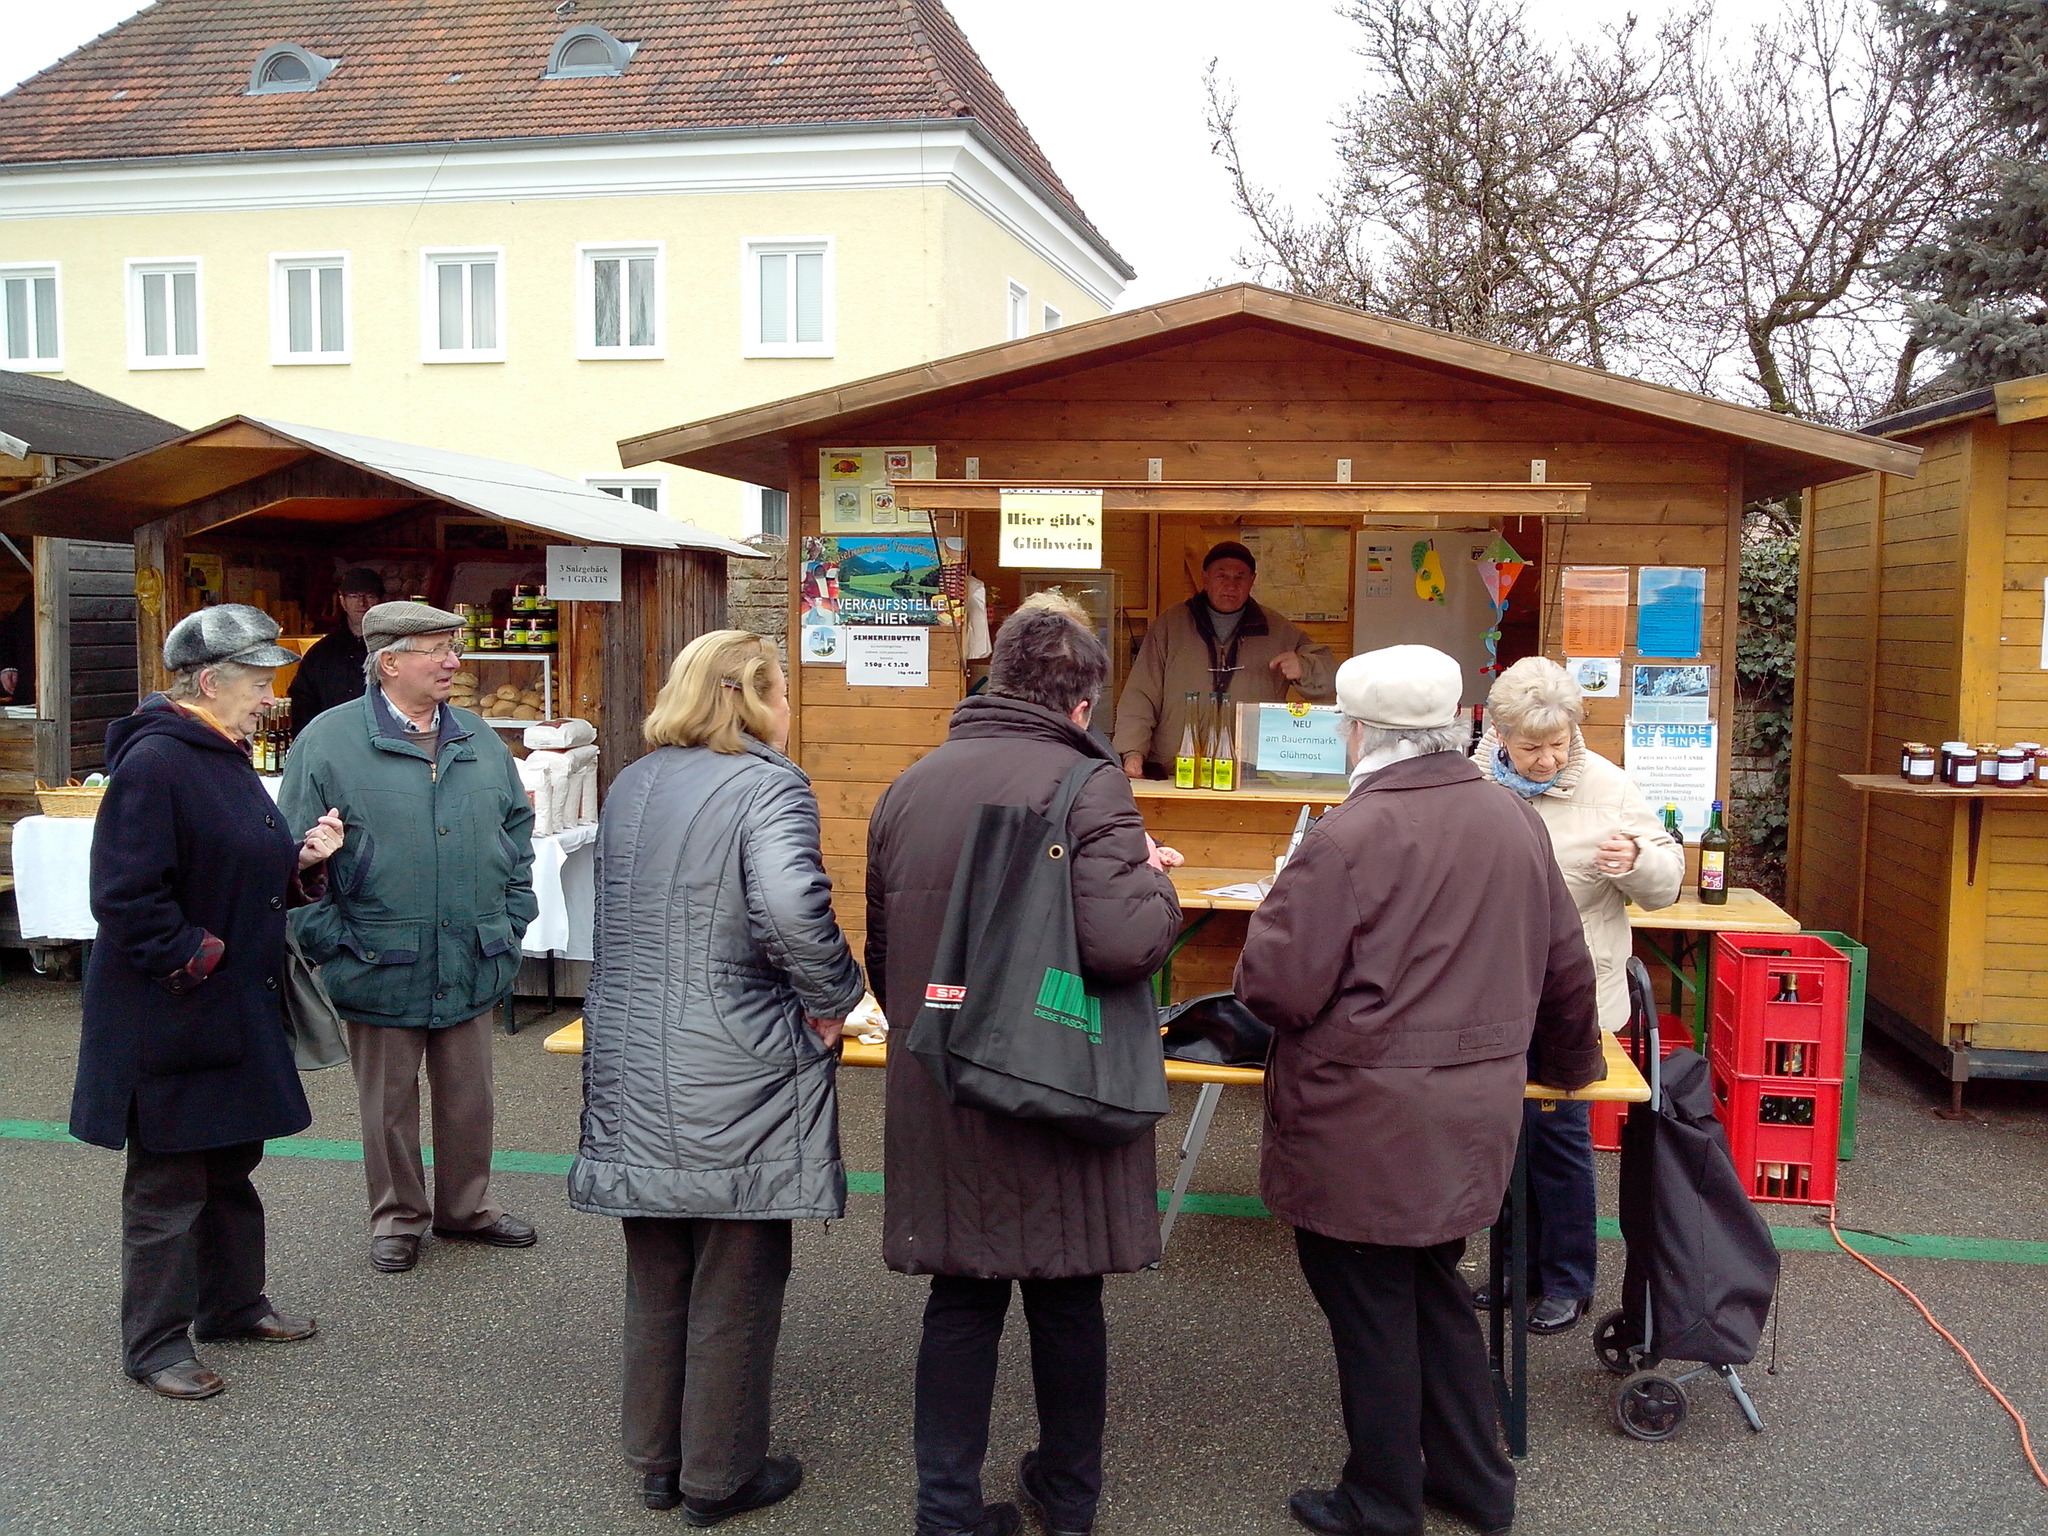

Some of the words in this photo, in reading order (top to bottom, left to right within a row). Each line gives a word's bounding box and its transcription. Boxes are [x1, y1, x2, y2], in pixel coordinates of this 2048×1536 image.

[1007, 512, 1045, 525] Hier
[1013, 537, 1093, 550] Glühwein
[559, 565, 564, 573] 3
[566, 564, 608, 574] Salzgebäck
[574, 575, 608, 584] GRATIS
[837, 598, 945, 611] VERKAUFSSTELLE
[875, 612, 909, 625] HIER
[1292, 720, 1312, 729] NEU
[1636, 724, 1707, 735] GESUNDE
[1281, 735, 1337, 746] Bauernmarkt
[1280, 750, 1321, 761] Glühmost
[1033, 1008, 1060, 1023] DIESE
